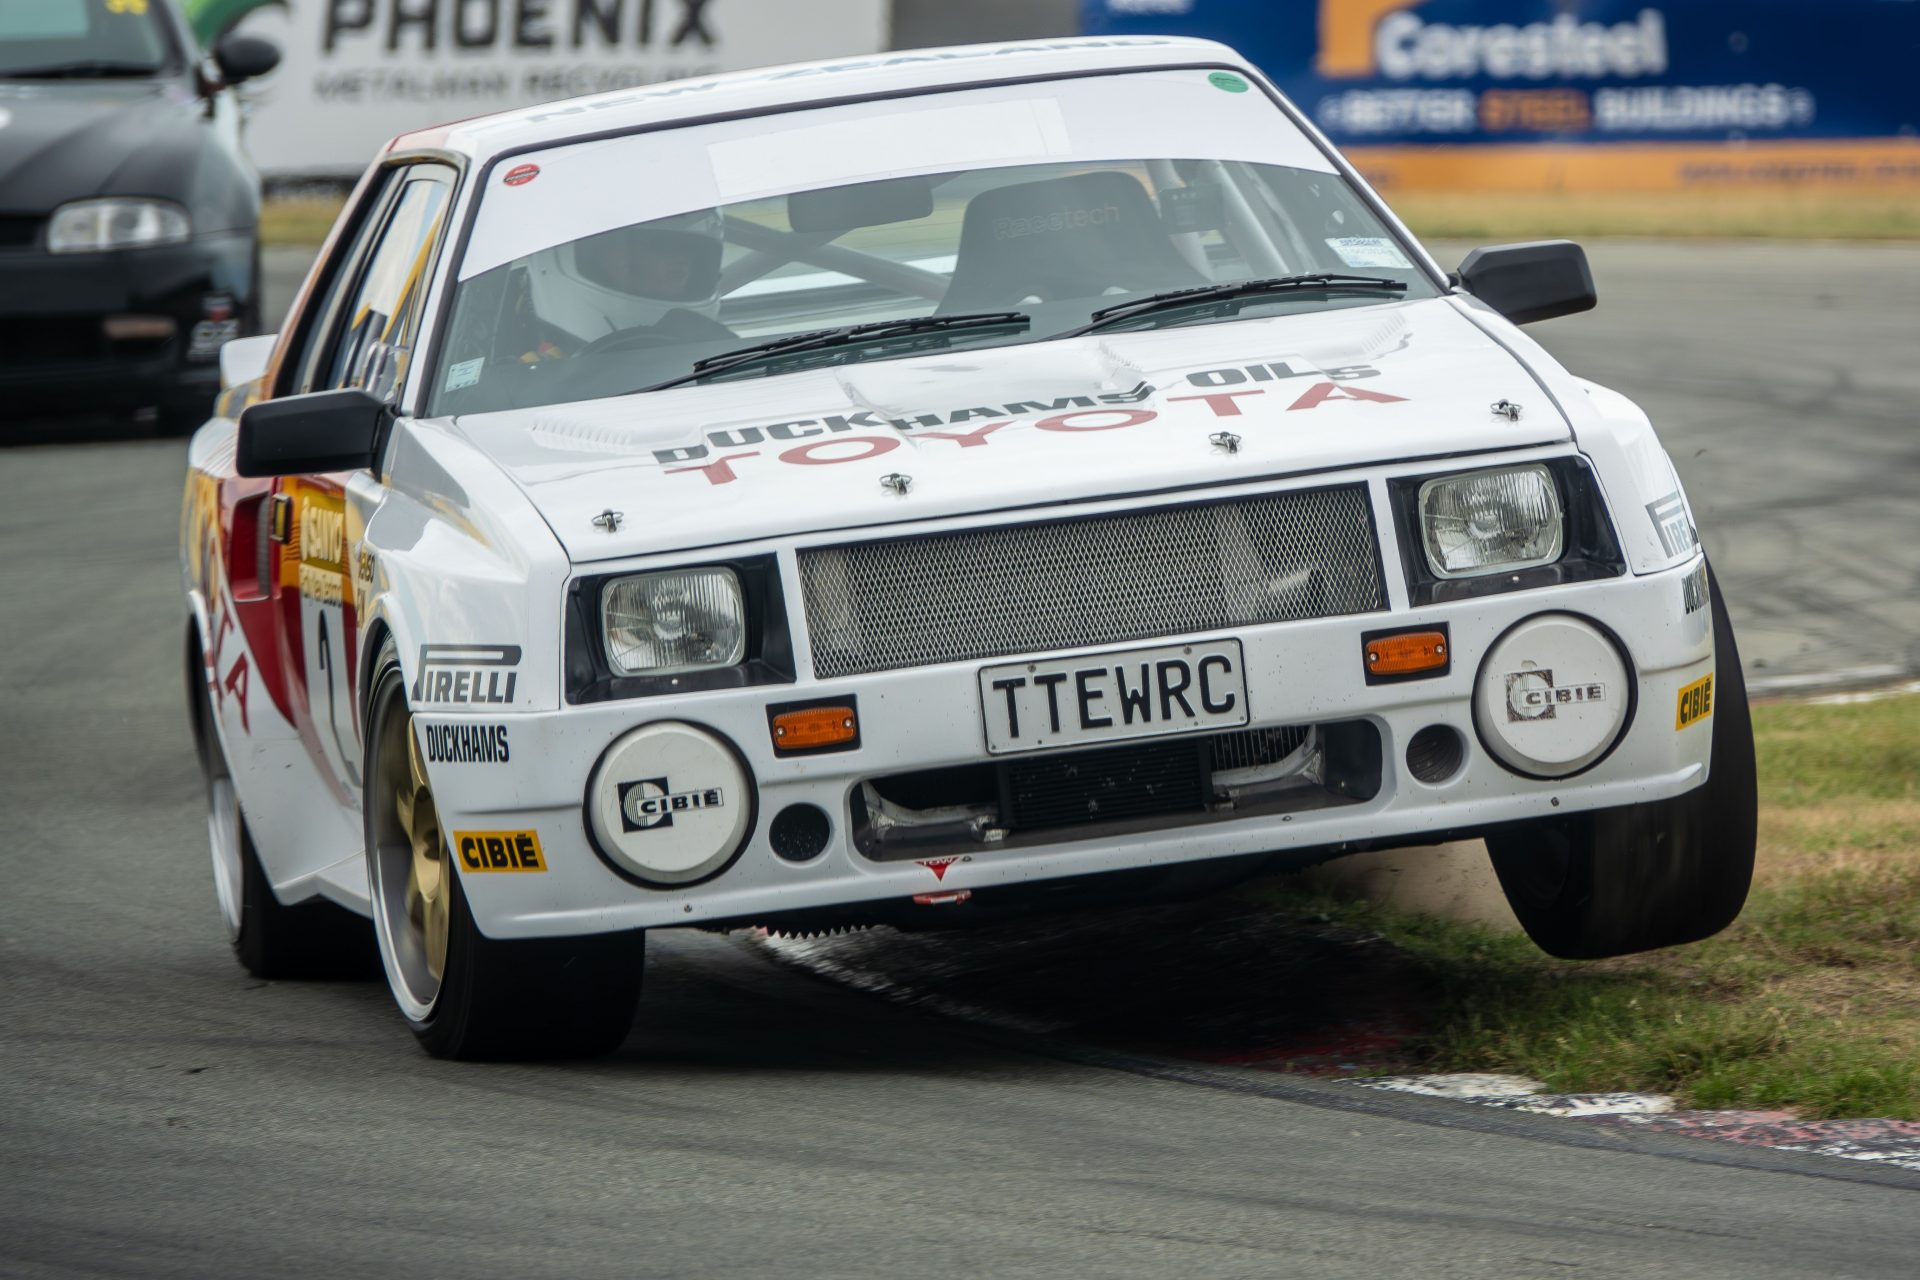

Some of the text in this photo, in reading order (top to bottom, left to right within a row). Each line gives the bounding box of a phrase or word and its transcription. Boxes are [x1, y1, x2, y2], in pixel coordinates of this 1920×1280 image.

[322, 0, 714, 52] PHOENIX
[1377, 8, 1667, 79] Coresteel
[768, 40, 1172, 80] ZEALAND
[1478, 88, 1592, 133] STEEL
[1594, 84, 1791, 131] BUILDINGS
[651, 362, 1381, 464] DUCKHAMS OILS
[664, 382, 1411, 485] TOYOTA
[411, 644, 522, 703] PIRELLI
[992, 655, 1236, 738] TTEWRC
[426, 725, 509, 762] DUCKHAMS
[461, 833, 539, 868] CIBIÉ
